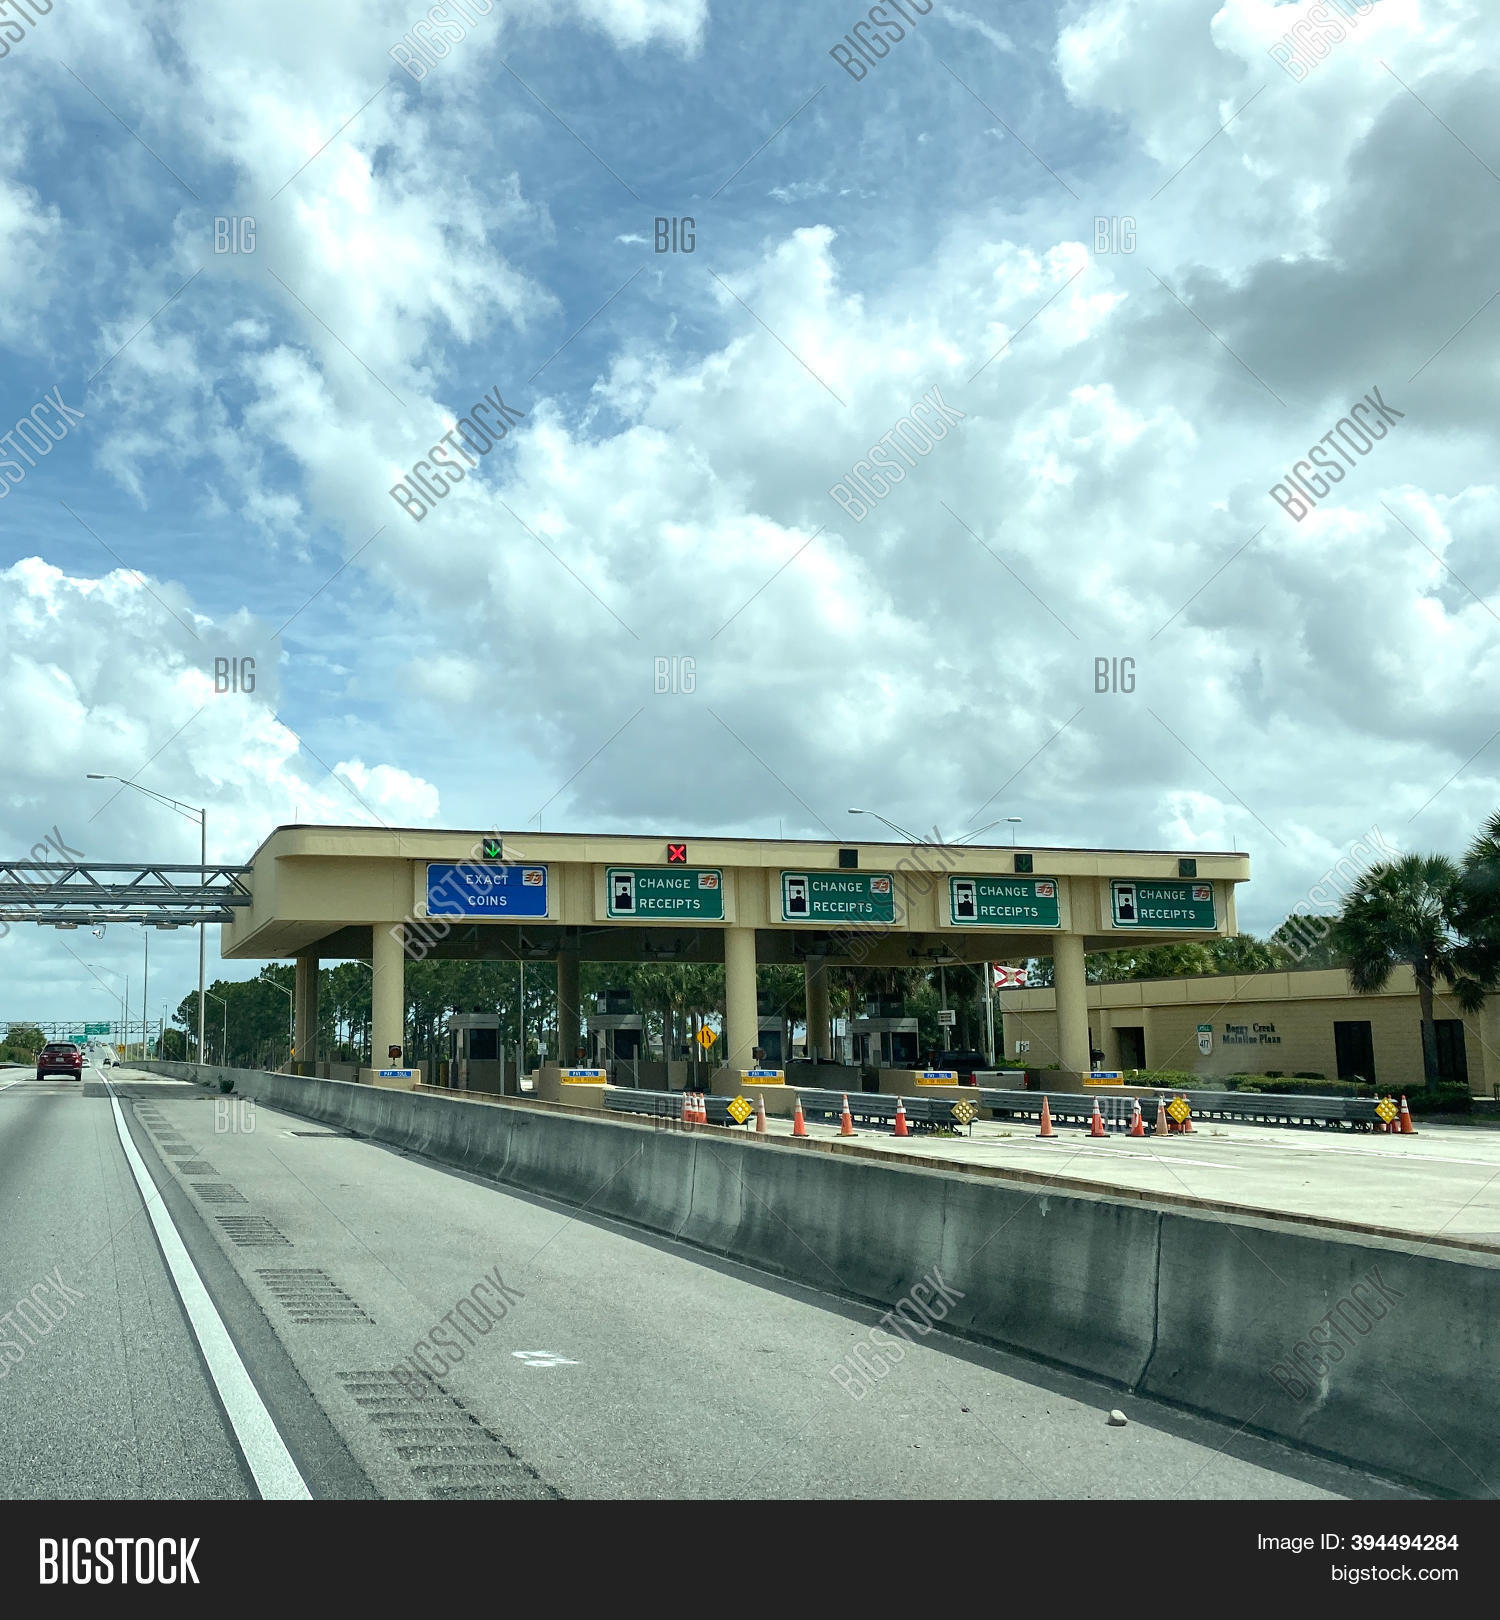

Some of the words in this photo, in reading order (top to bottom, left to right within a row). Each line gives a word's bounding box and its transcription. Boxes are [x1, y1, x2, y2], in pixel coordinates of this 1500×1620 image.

[466, 874, 509, 885] EXACT
[639, 878, 691, 889] CHANGE
[812, 881, 863, 893] CHANGE
[980, 886, 1029, 897] CHANGE
[1139, 889, 1186, 900] CHANGE
[468, 895, 507, 906] COINS
[639, 898, 701, 909] RECEIPTS
[813, 901, 873, 913] RECEIPTS
[980, 905, 1039, 917] RECEIPTS
[1140, 908, 1196, 919] RECEIPTS
[1252, 1022, 1276, 1033] Creek
[1259, 1034, 1281, 1045] Plaza
